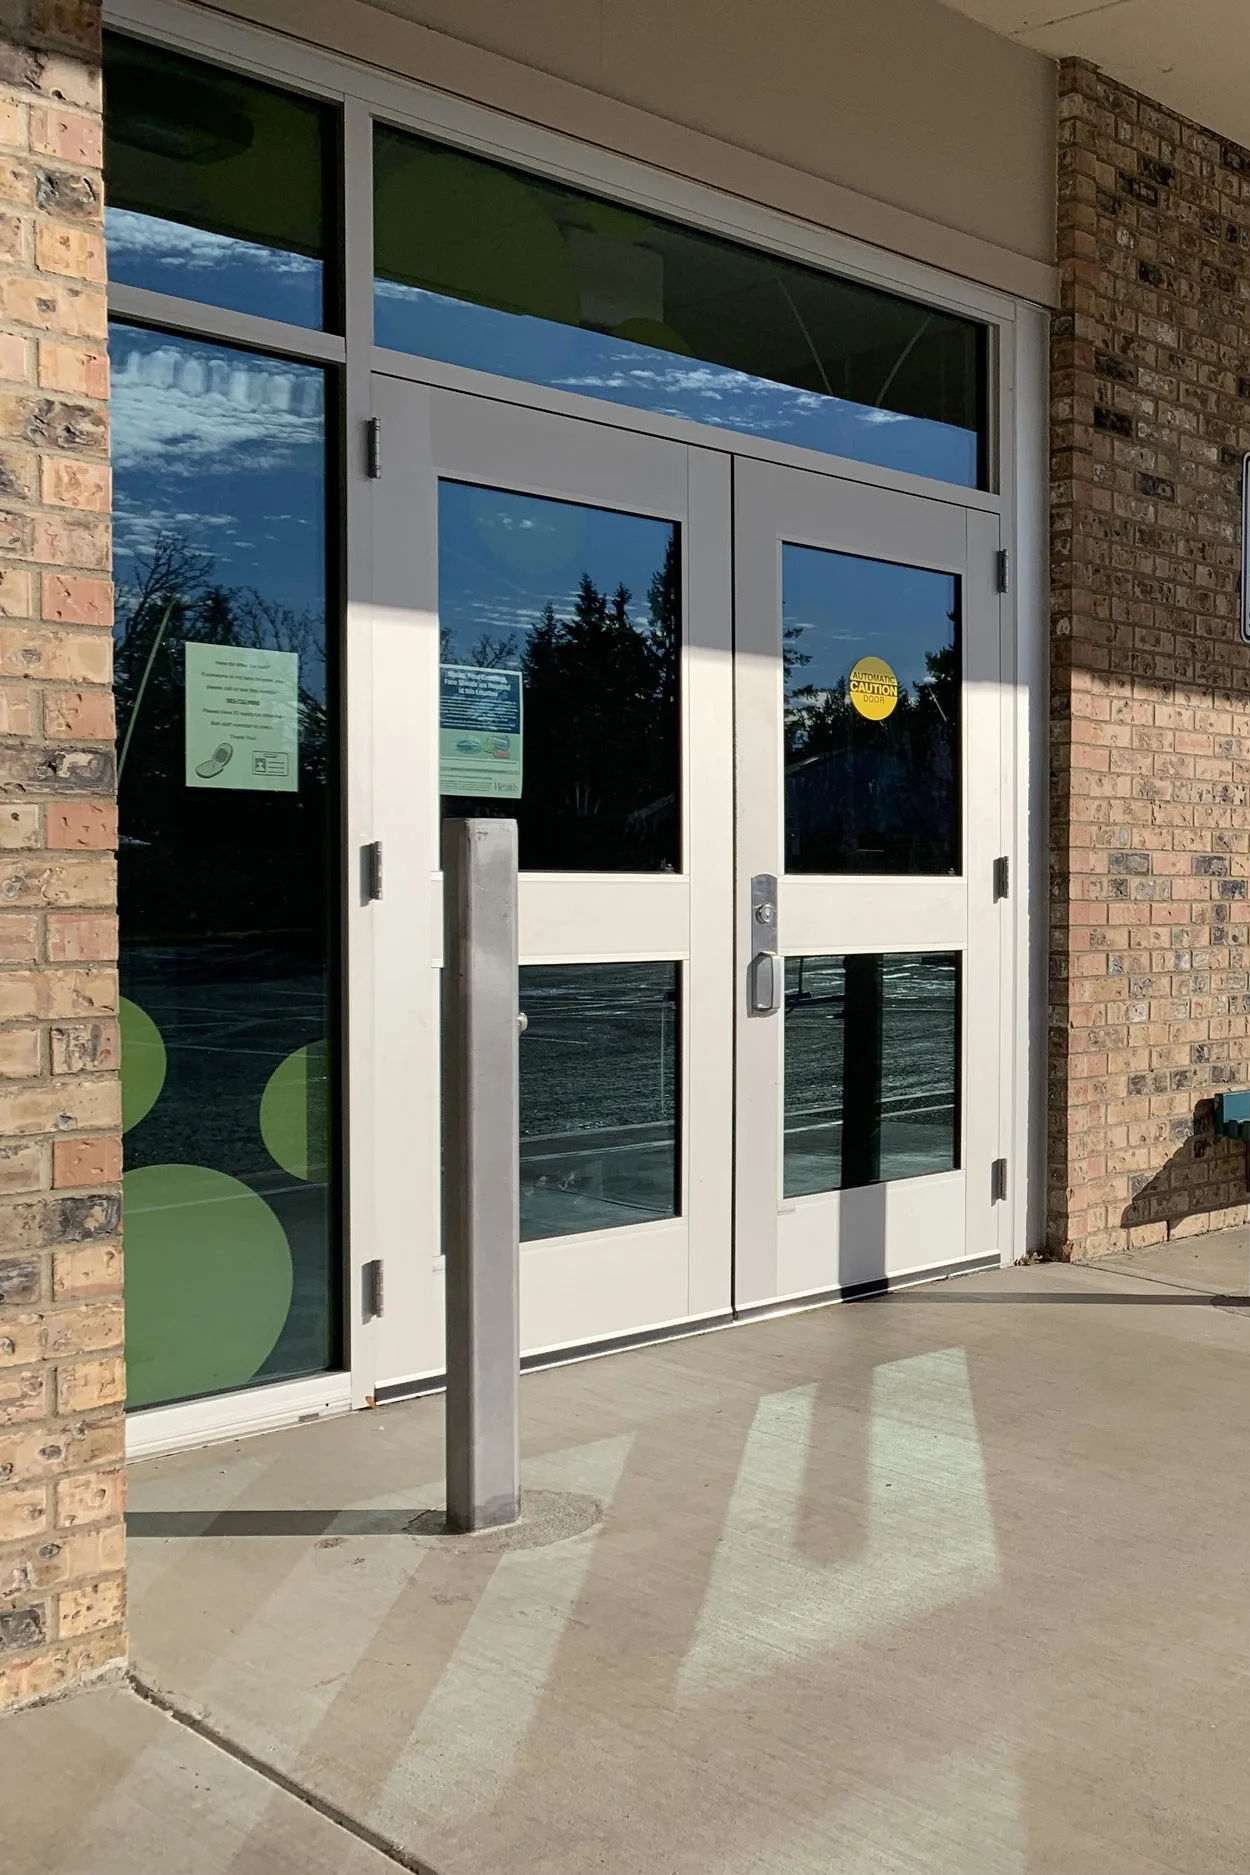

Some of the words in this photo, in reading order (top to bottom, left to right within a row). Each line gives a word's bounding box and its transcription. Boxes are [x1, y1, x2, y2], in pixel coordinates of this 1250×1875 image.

[852, 671, 895, 684] AUTOMATIC
[850, 681, 898, 697] CAUTION
[863, 694, 885, 704] DOOR
